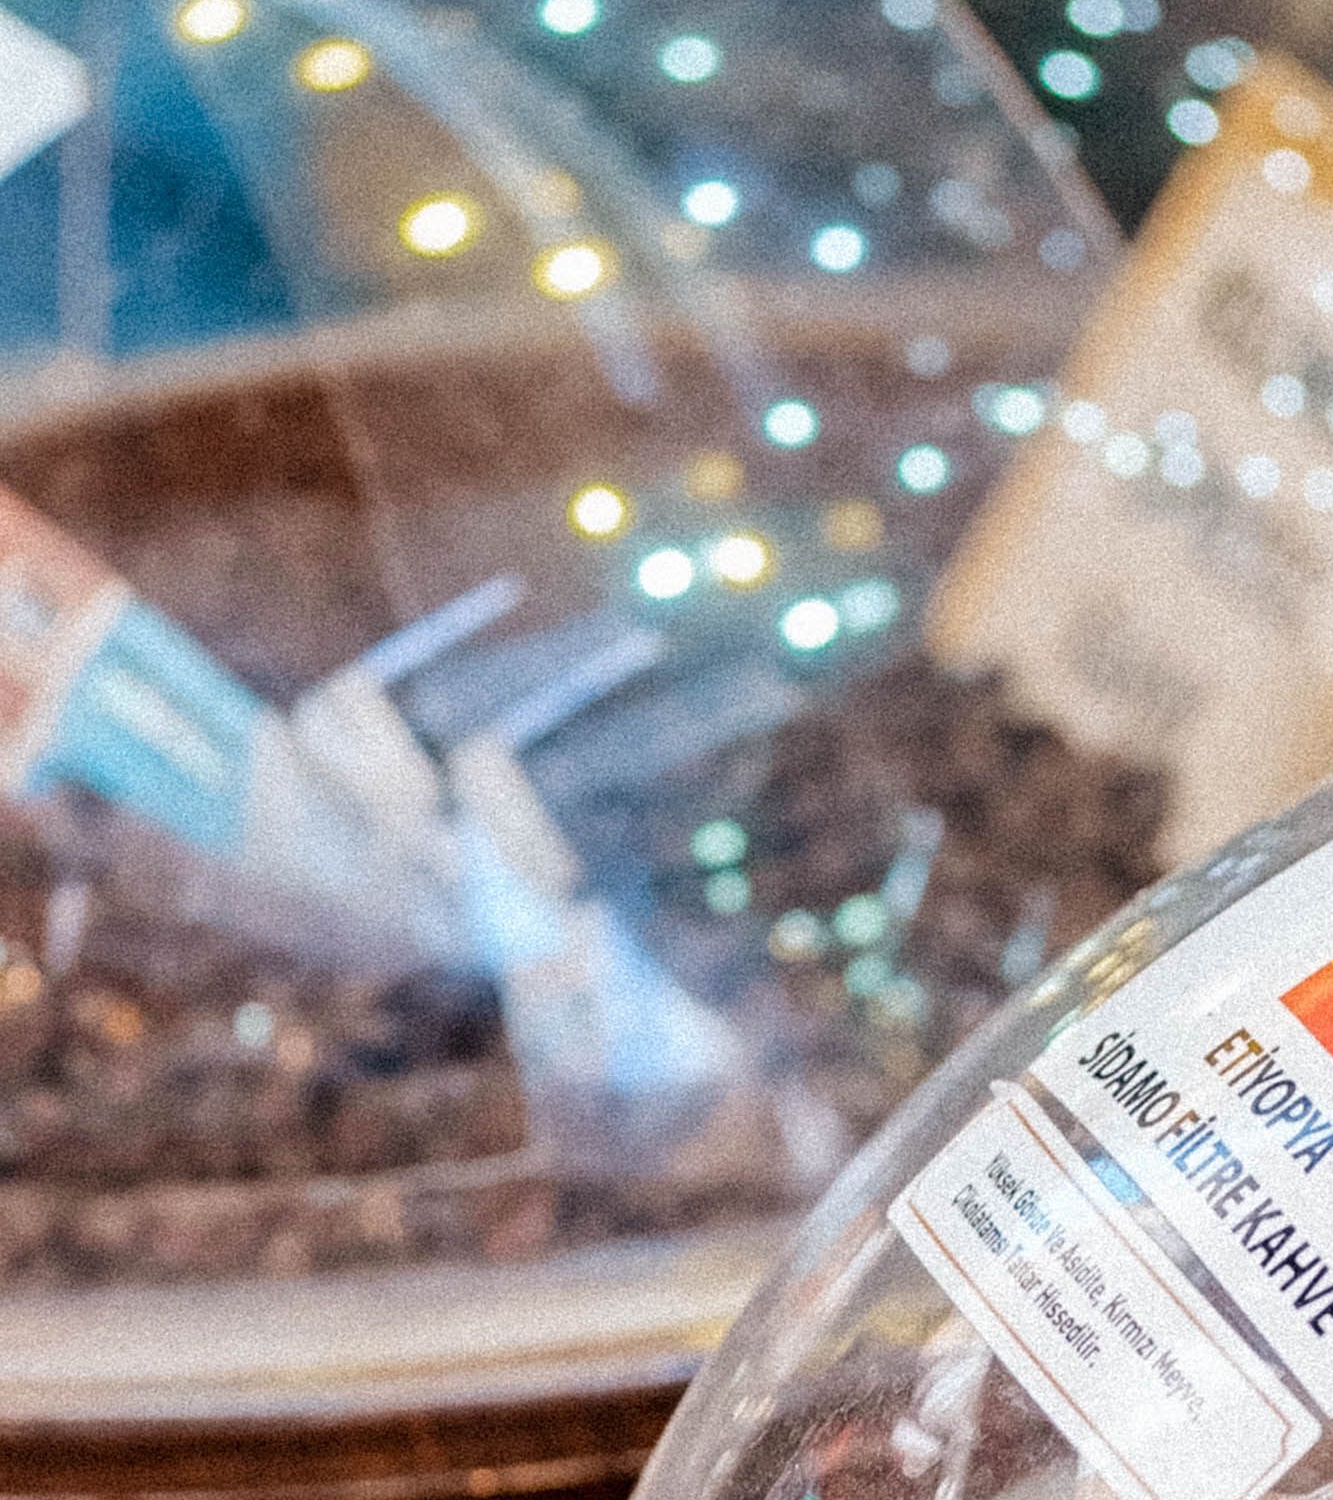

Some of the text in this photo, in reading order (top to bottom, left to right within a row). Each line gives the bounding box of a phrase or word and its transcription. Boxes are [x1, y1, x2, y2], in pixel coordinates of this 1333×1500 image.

[1078, 1029, 1182, 1128] SİDAMO
[1154, 1108, 1261, 1219] FİLTRE
[952, 1183, 1010, 1256] Çikolatamsı
[1034, 1283, 1101, 1368] Hissedilir.
[984, 1150, 1023, 1206] Yüksek
[1013, 1189, 1052, 1235] Gövde
[1043, 1223, 1066, 1254] Ve
[1057, 1244, 1106, 1308] Asidite,
[1101, 1293, 1157, 1360] Kırmızı
